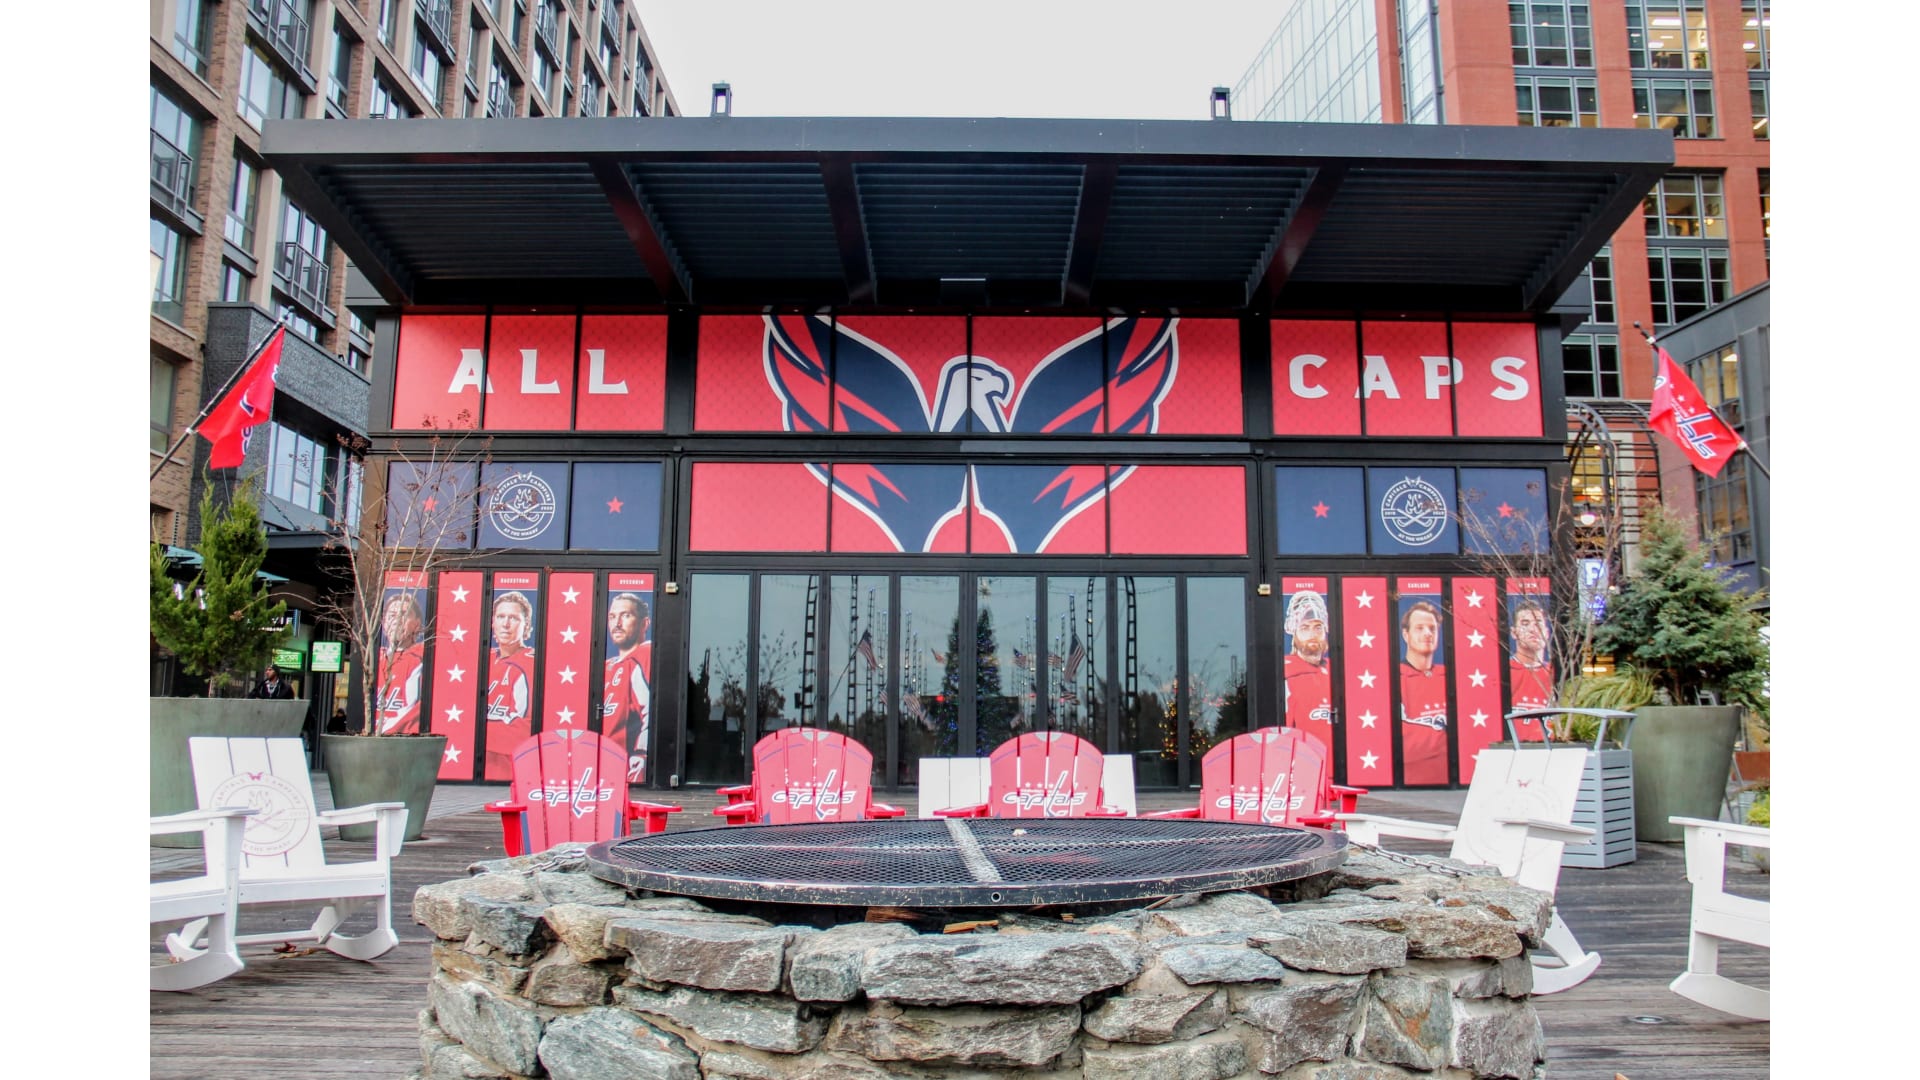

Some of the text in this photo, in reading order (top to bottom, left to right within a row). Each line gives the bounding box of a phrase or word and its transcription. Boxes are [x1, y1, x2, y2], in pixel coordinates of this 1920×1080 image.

[448, 348, 1530, 401] ALL CAPS
[528, 767, 615, 819] captals
[771, 769, 857, 821] captals
[1002, 770, 1088, 817] captals
[1216, 773, 1306, 823] captals
